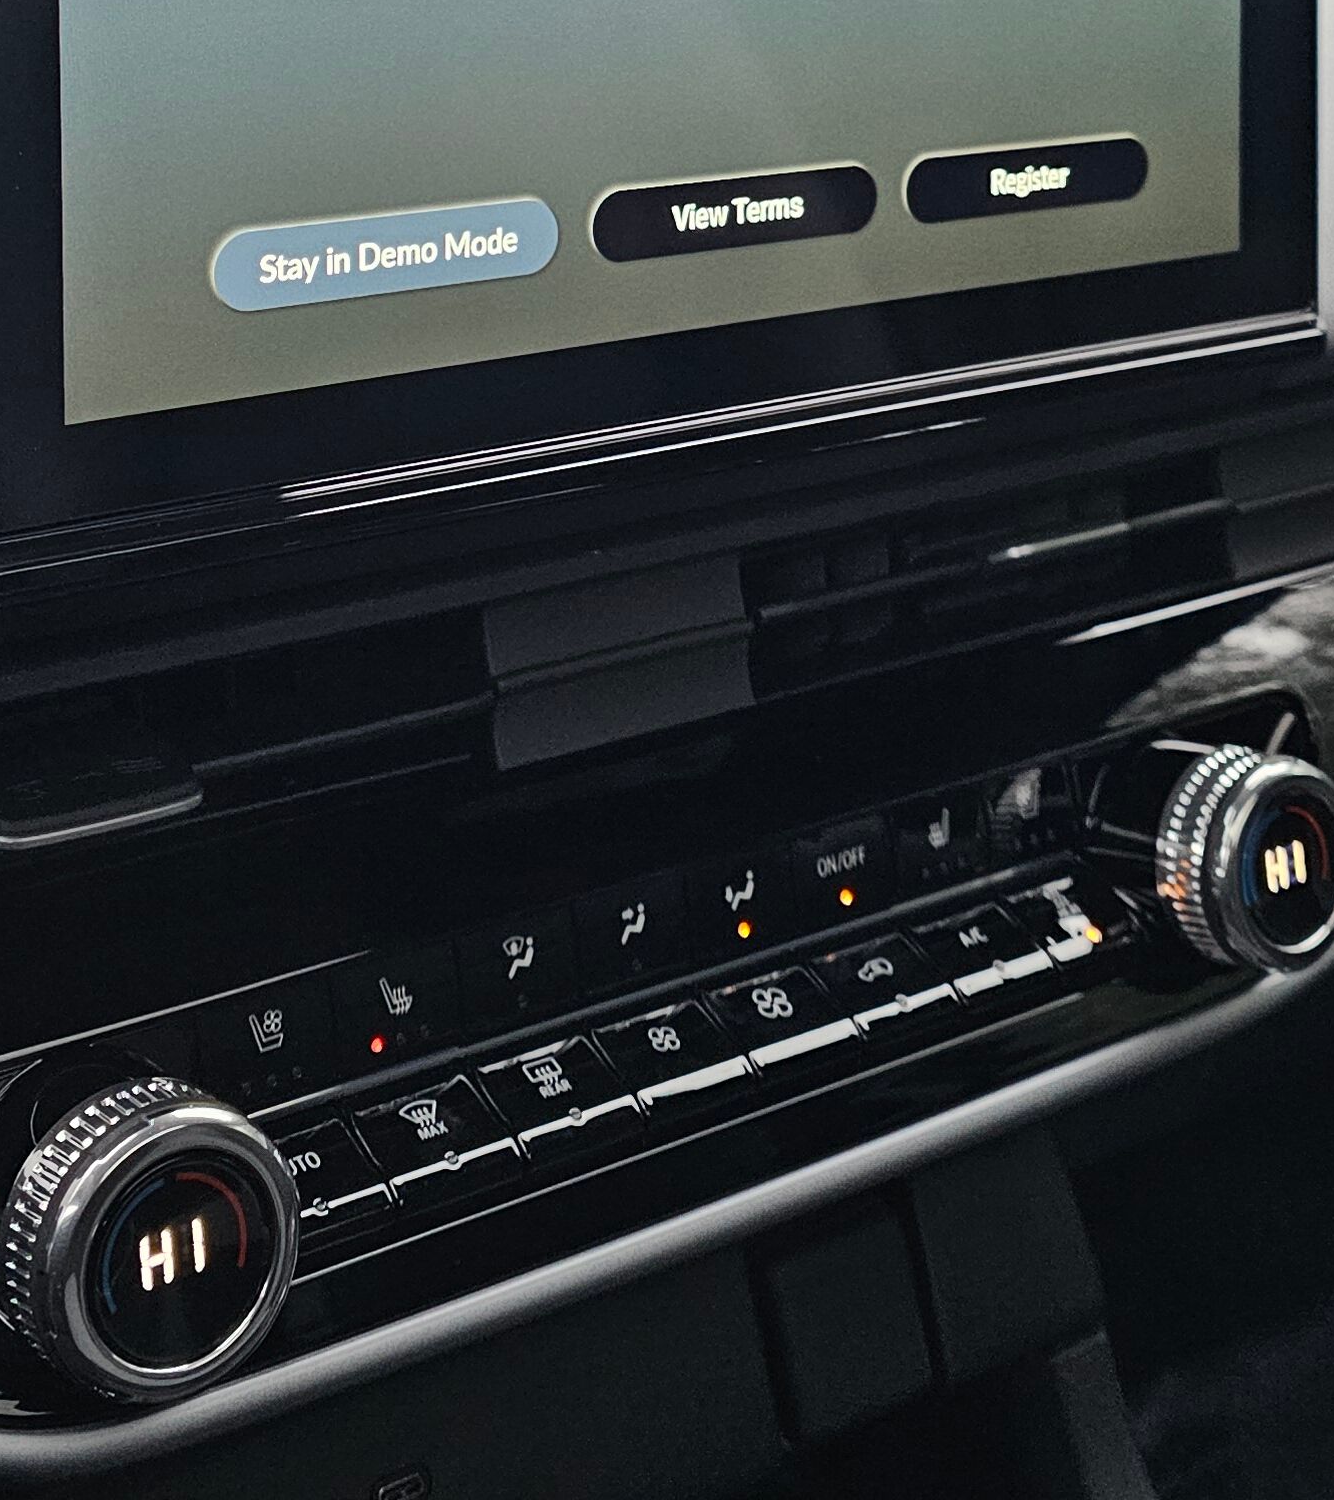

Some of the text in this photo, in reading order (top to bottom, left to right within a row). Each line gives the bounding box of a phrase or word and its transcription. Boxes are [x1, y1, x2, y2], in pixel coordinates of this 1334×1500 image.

[989, 165, 1071, 199] Register
[670, 195, 806, 232] View Terms
[259, 226, 519, 285] Stay in Demo Mode
[817, 845, 866, 878] ON/OFF
[538, 1079, 573, 1100] REAR
[417, 1121, 449, 1141] MAX
[138, 1218, 208, 1293] HI
